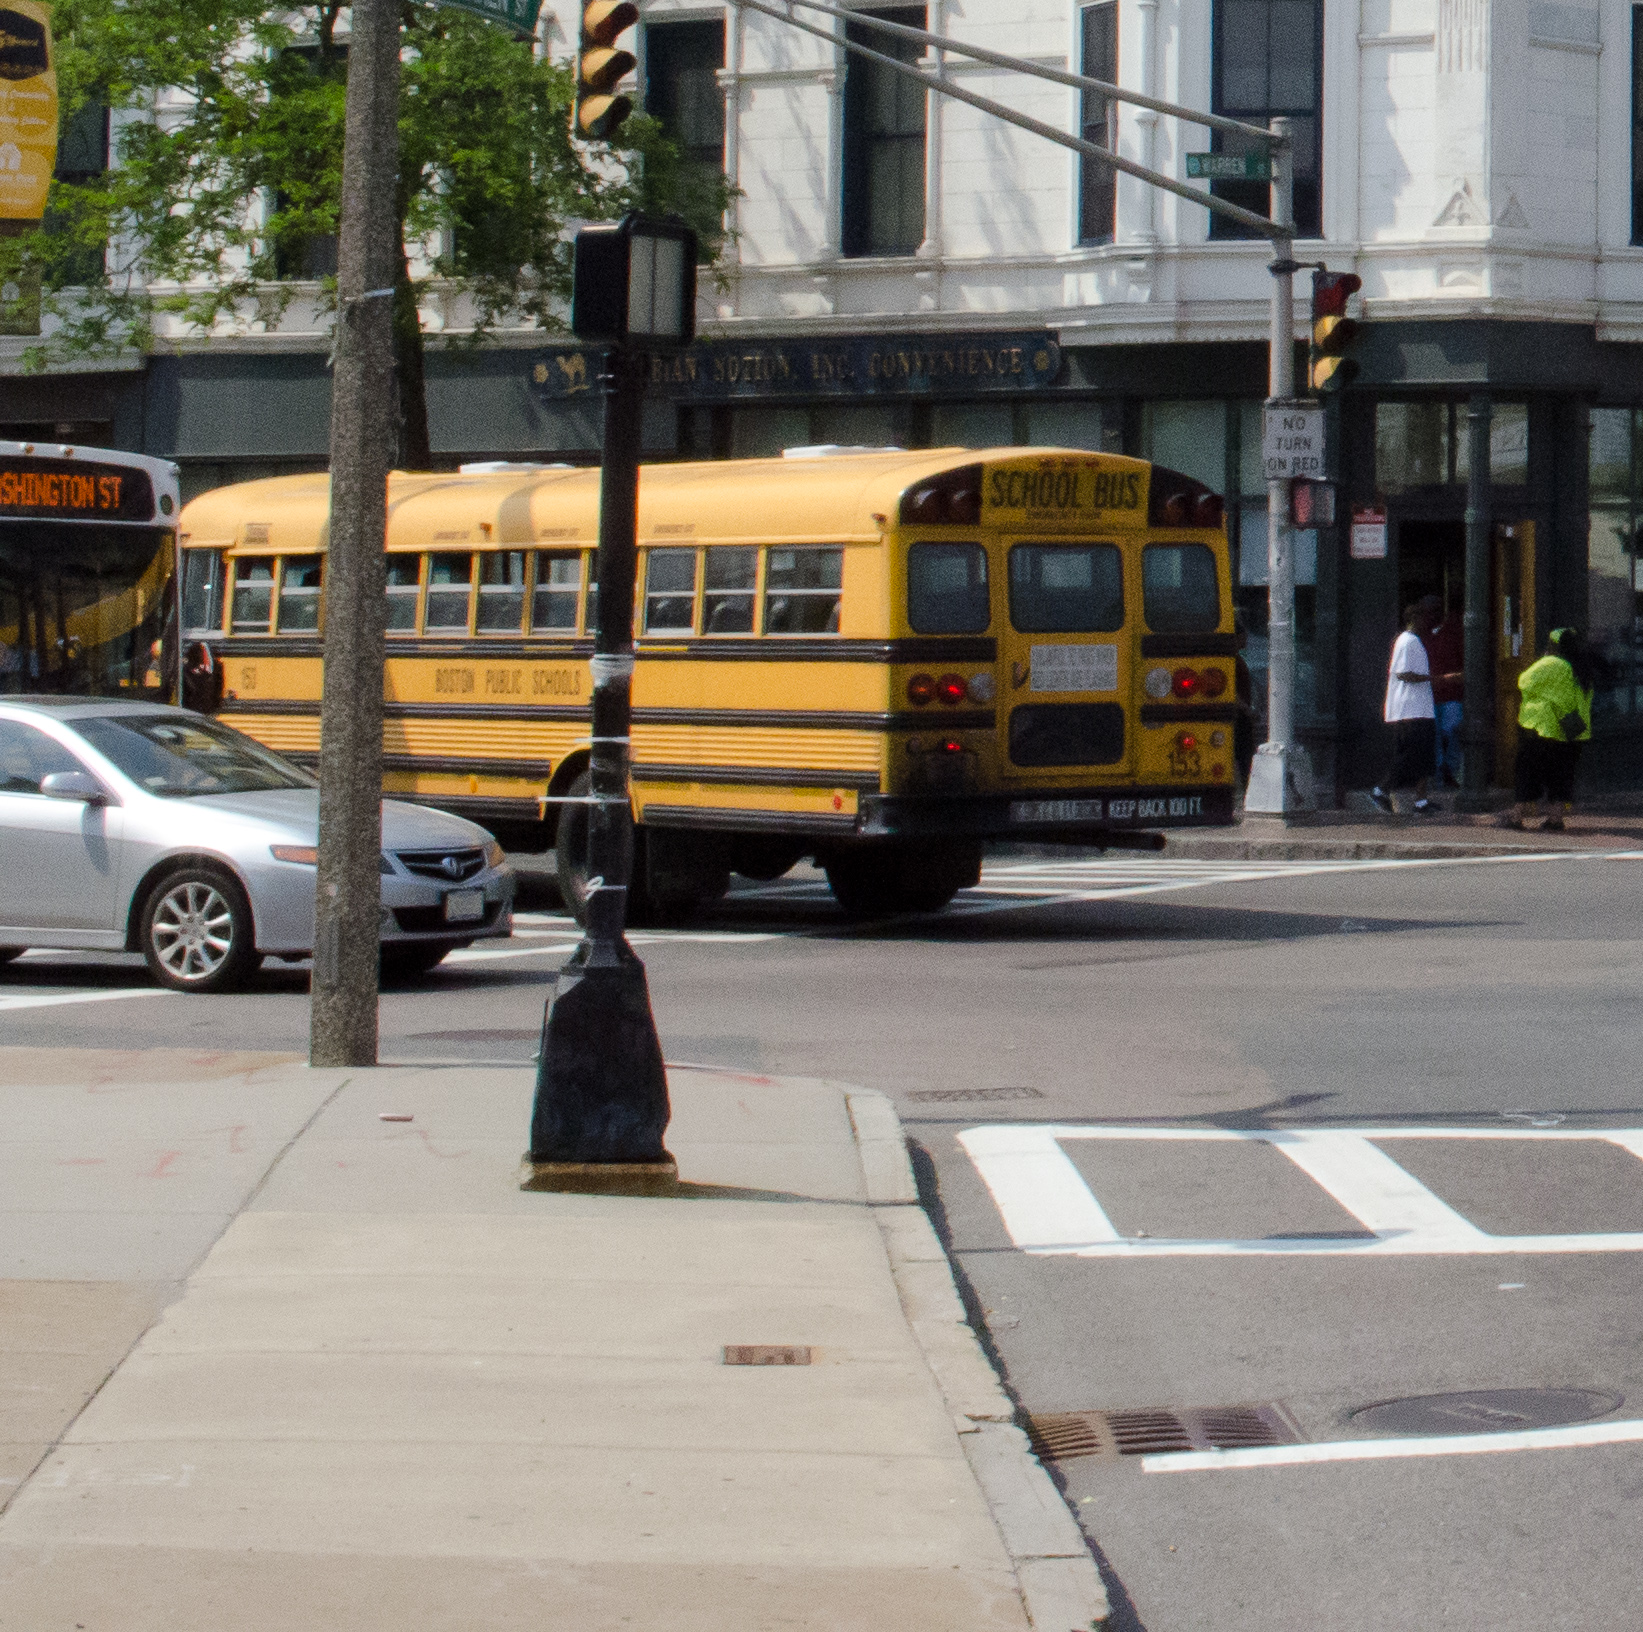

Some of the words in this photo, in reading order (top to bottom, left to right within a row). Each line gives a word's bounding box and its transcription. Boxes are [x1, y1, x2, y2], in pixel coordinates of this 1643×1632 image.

[868, 347, 1023, 378] CONVENIENCE
[1283, 416, 1306, 431] NO
[1276, 437, 1312, 450] TURN
[1267, 457, 1288, 470] ON
[1292, 456, 1319, 470] RED
[100, 476, 122, 509] ST
[990, 470, 1081, 509] SCHOOL
[1094, 472, 1140, 510] BUS
[435, 667, 475, 694] BOSTON
[485, 668, 523, 695] PUBLIC
[532, 669, 581, 696] SCHOOLS
[1168, 750, 1201, 778] 153
[1108, 799, 1136, 819] KEEP
[1138, 798, 1167, 818] BACK
[1169, 797, 1187, 817] 100
